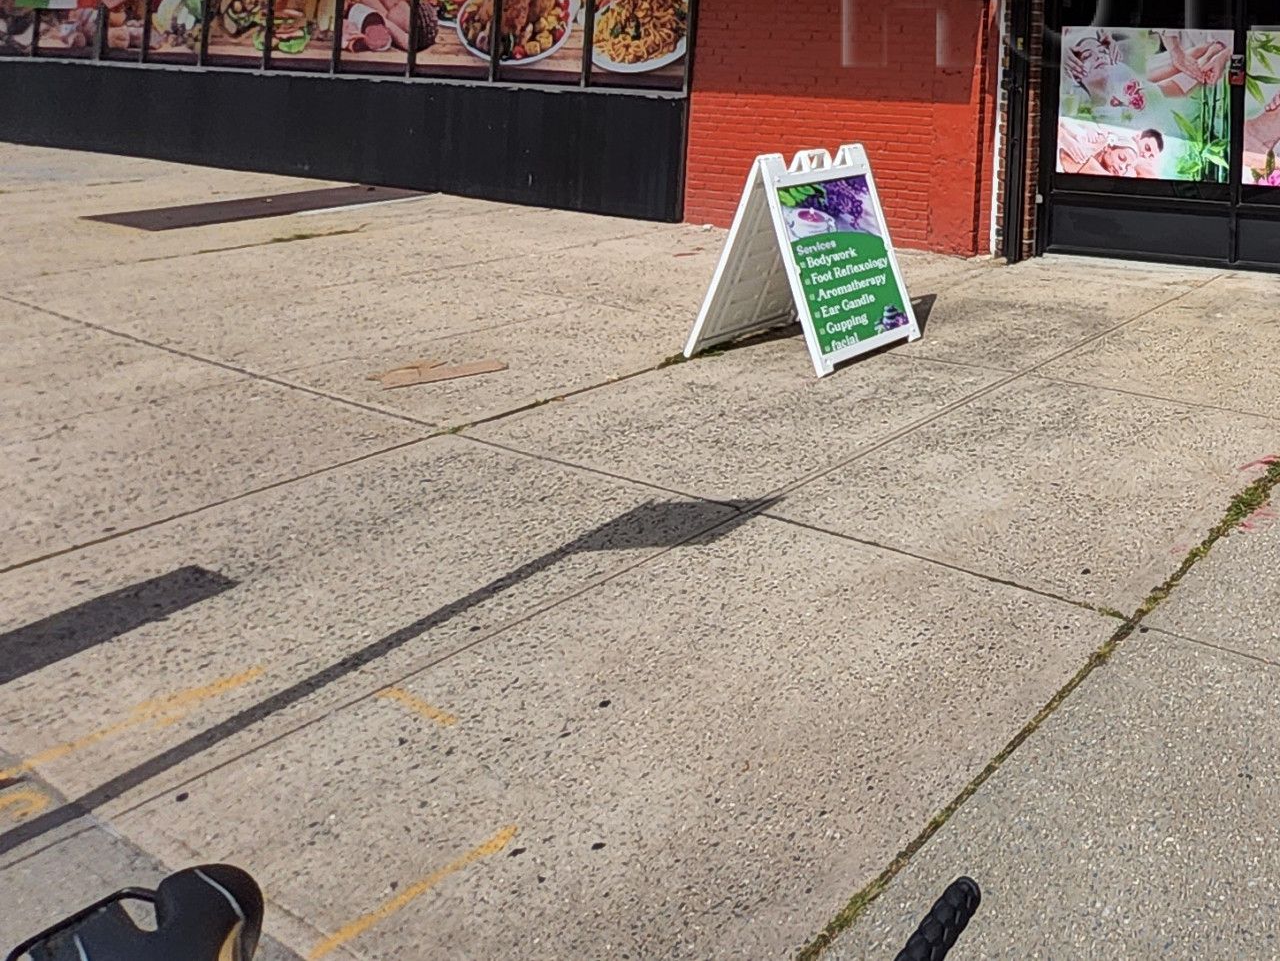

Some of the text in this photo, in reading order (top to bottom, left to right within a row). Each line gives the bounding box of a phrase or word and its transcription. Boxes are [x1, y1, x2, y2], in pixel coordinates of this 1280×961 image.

[796, 240, 836, 255] Services
[806, 247, 858, 268] Bodywork
[811, 257, 888, 285] Foot Reflexology
[817, 274, 886, 301] Aromatherapy
[820, 304, 841, 318] Ear
